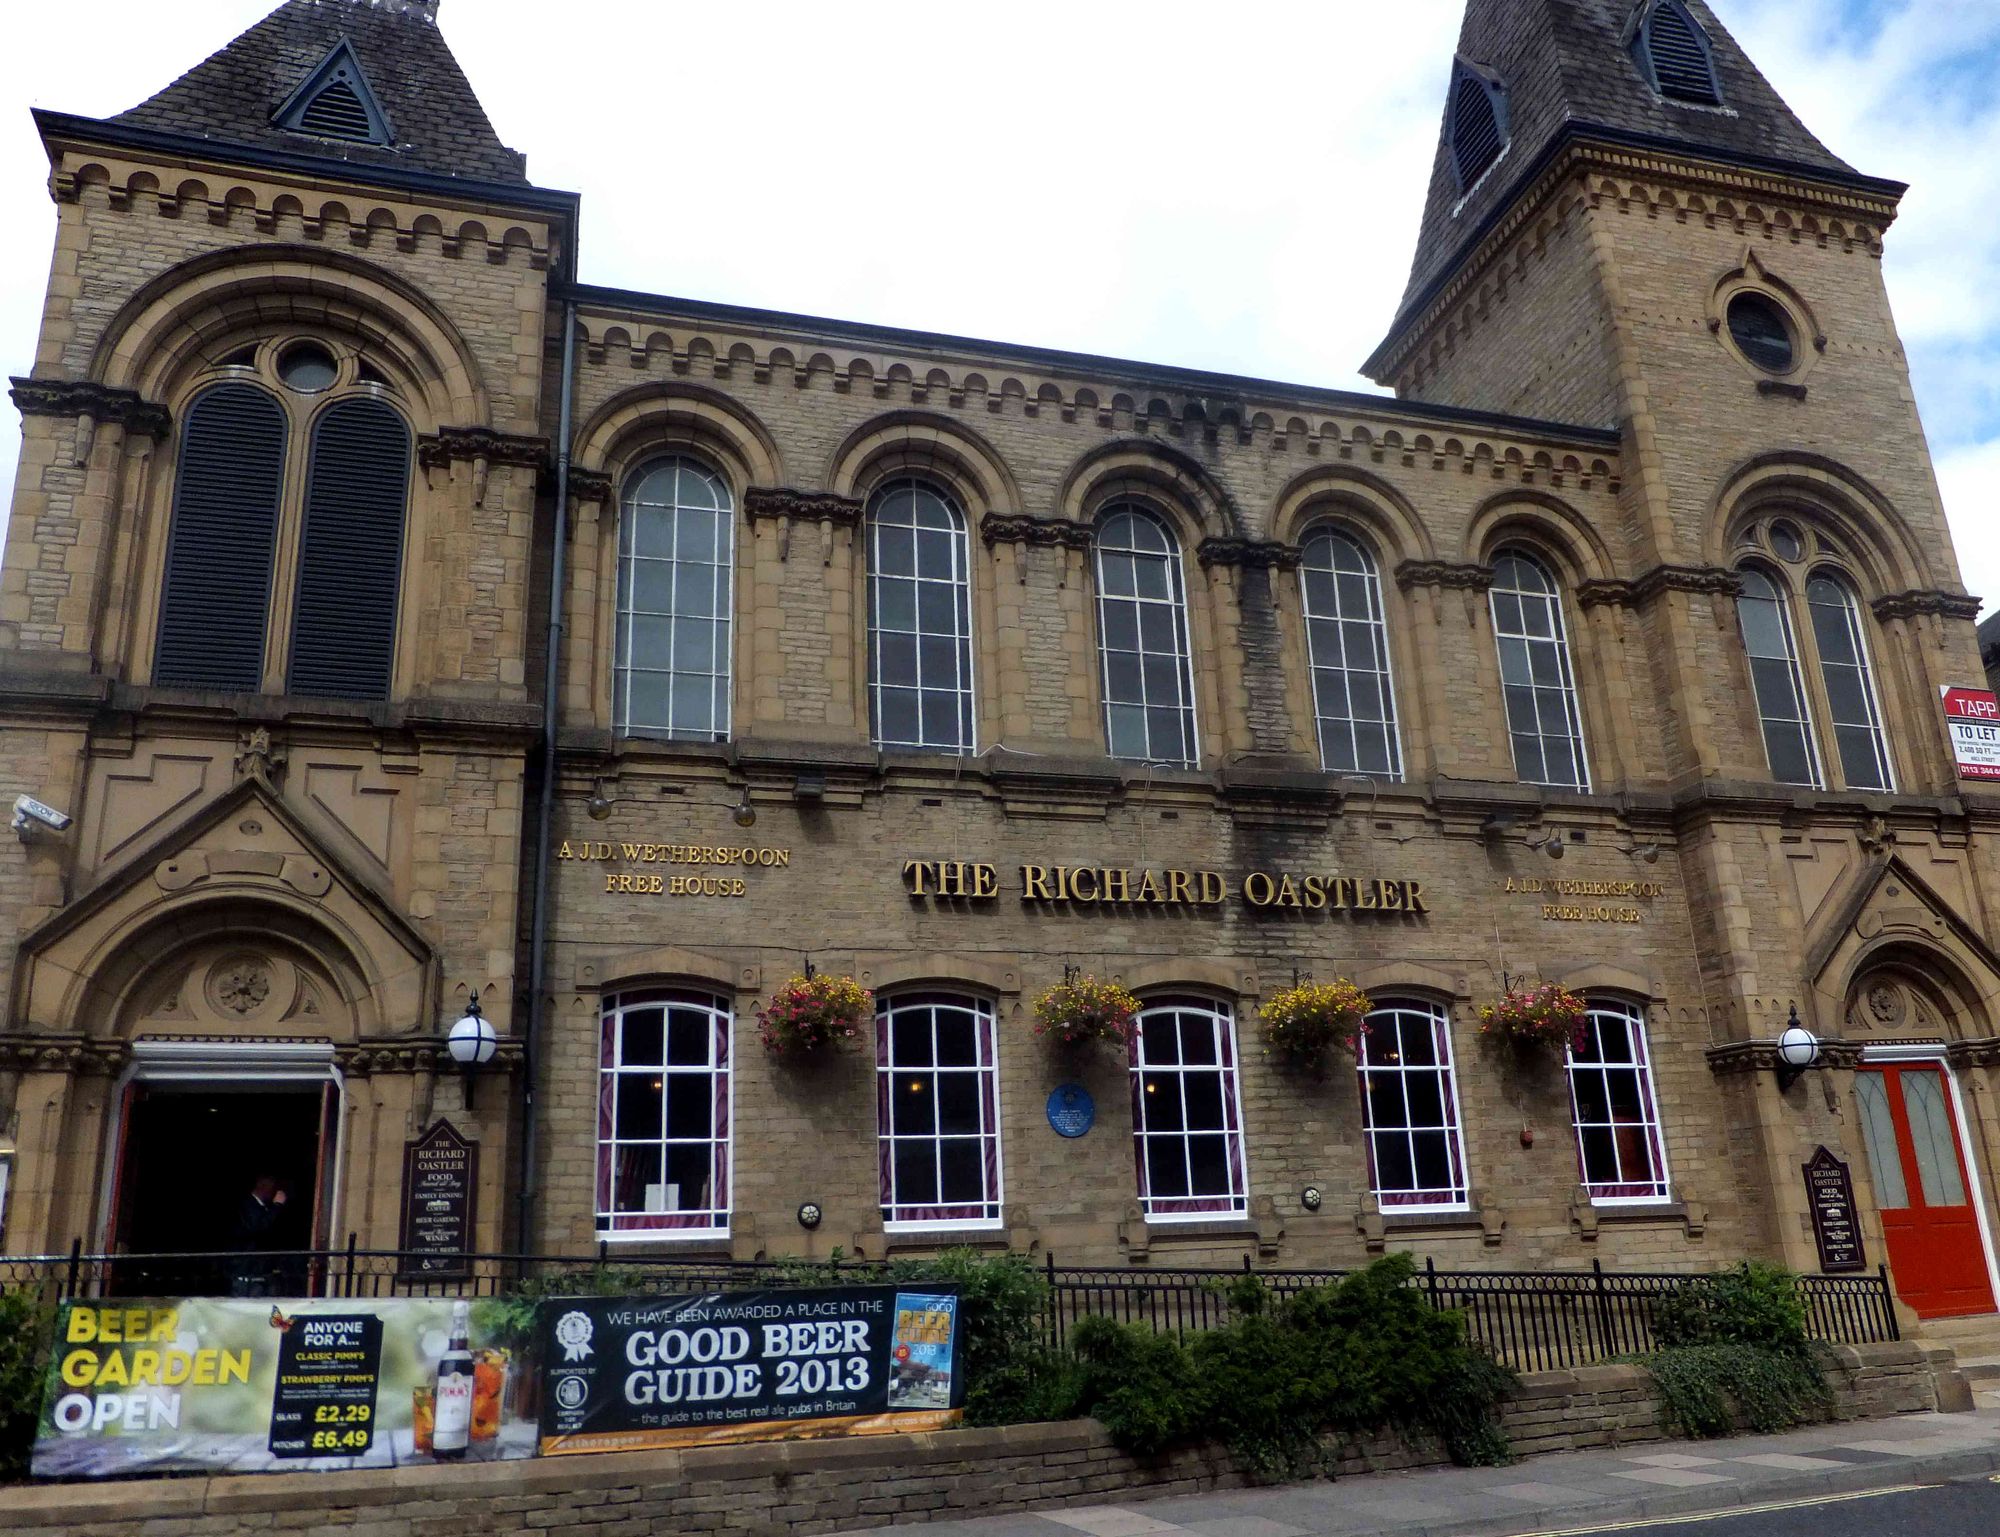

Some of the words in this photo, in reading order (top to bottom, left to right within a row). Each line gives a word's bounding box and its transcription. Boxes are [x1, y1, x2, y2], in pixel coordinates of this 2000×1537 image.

[1955, 699, 1996, 717] TAPP
[1957, 726, 1973, 739] TO
[1976, 727, 1996, 741] LET
[558, 841, 574, 860] A
[580, 842, 617, 860] J.D.
[620, 843, 790, 867] WETHERSPOON
[605, 874, 664, 893] FREE
[669, 876, 746, 896] HOUSE
[903, 858, 999, 899] THE
[1021, 863, 1228, 905] RICHARD
[1242, 870, 1431, 913] OASTLER
[1504, 876, 1516, 893] A
[1549, 879, 1664, 898] WETHERSPOON
[1541, 904, 1582, 921] FREE
[1586, 906, 1641, 923] HOUSE
[434, 1140, 450, 1148] THE
[418, 1149, 465, 1160] RICHARD
[418, 1160, 464, 1170] OASTLER
[1812, 1169, 1841, 1178] RICHARD
[427, 1173, 453, 1181] FOOD
[1814, 1178, 1842, 1186] OASTLER
[607, 1311, 631, 1325] WE
[635, 1310, 672, 1324] HAVE
[675, 1308, 709, 1323] BEEN
[713, 1304, 782, 1320] AWARDED
[784, 1304, 795, 1317] A
[798, 1302, 838, 1317] PLACE
[841, 1302, 855, 1314] IN
[858, 1300, 883, 1313] THE
[925, 1302, 953, 1313] GOOD
[66, 1306, 179, 1343] BEER
[303, 1321, 364, 1334] ANYONE
[898, 1309, 951, 1329] BEER
[304, 1334, 334, 1346] FOR
[625, 1326, 750, 1367] GOOD
[761, 1320, 872, 1358] BEER
[896, 1328, 951, 1344] GUIDE
[295, 1352, 333, 1361] CLASSIC
[335, 1351, 365, 1360] PIMM'S
[913, 1344, 937, 1356] 2013
[61, 1348, 251, 1388] GARDEN
[550, 1368, 587, 1376] SUPPORTED
[588, 1367, 597, 1375] BY
[281, 1375, 341, 1385] STRAWBERRY
[344, 1374, 375, 1383] PIMM'S
[624, 1363, 762, 1405] GUIDE
[775, 1356, 870, 1395] 2013
[54, 1392, 181, 1432] OPEN
[275, 1413, 301, 1421] GLASS
[314, 1404, 371, 1423] £2.29
[641, 1412, 659, 1425] the
[661, 1410, 690, 1426] guide
[692, 1410, 704, 1421] to
[706, 1408, 723, 1421] the
[726, 1407, 748, 1419] best
[750, 1405, 769, 1417] real
[771, 1404, 786, 1416] ale
[788, 1402, 812, 1418] pubs
[814, 1401, 824, 1411] in
[826, 1399, 857, 1412] Britain
[272, 1440, 305, 1449] PITCHER
[312, 1430, 368, 1448] £6.49
[556, 1435, 644, 1449] wetherspoon
